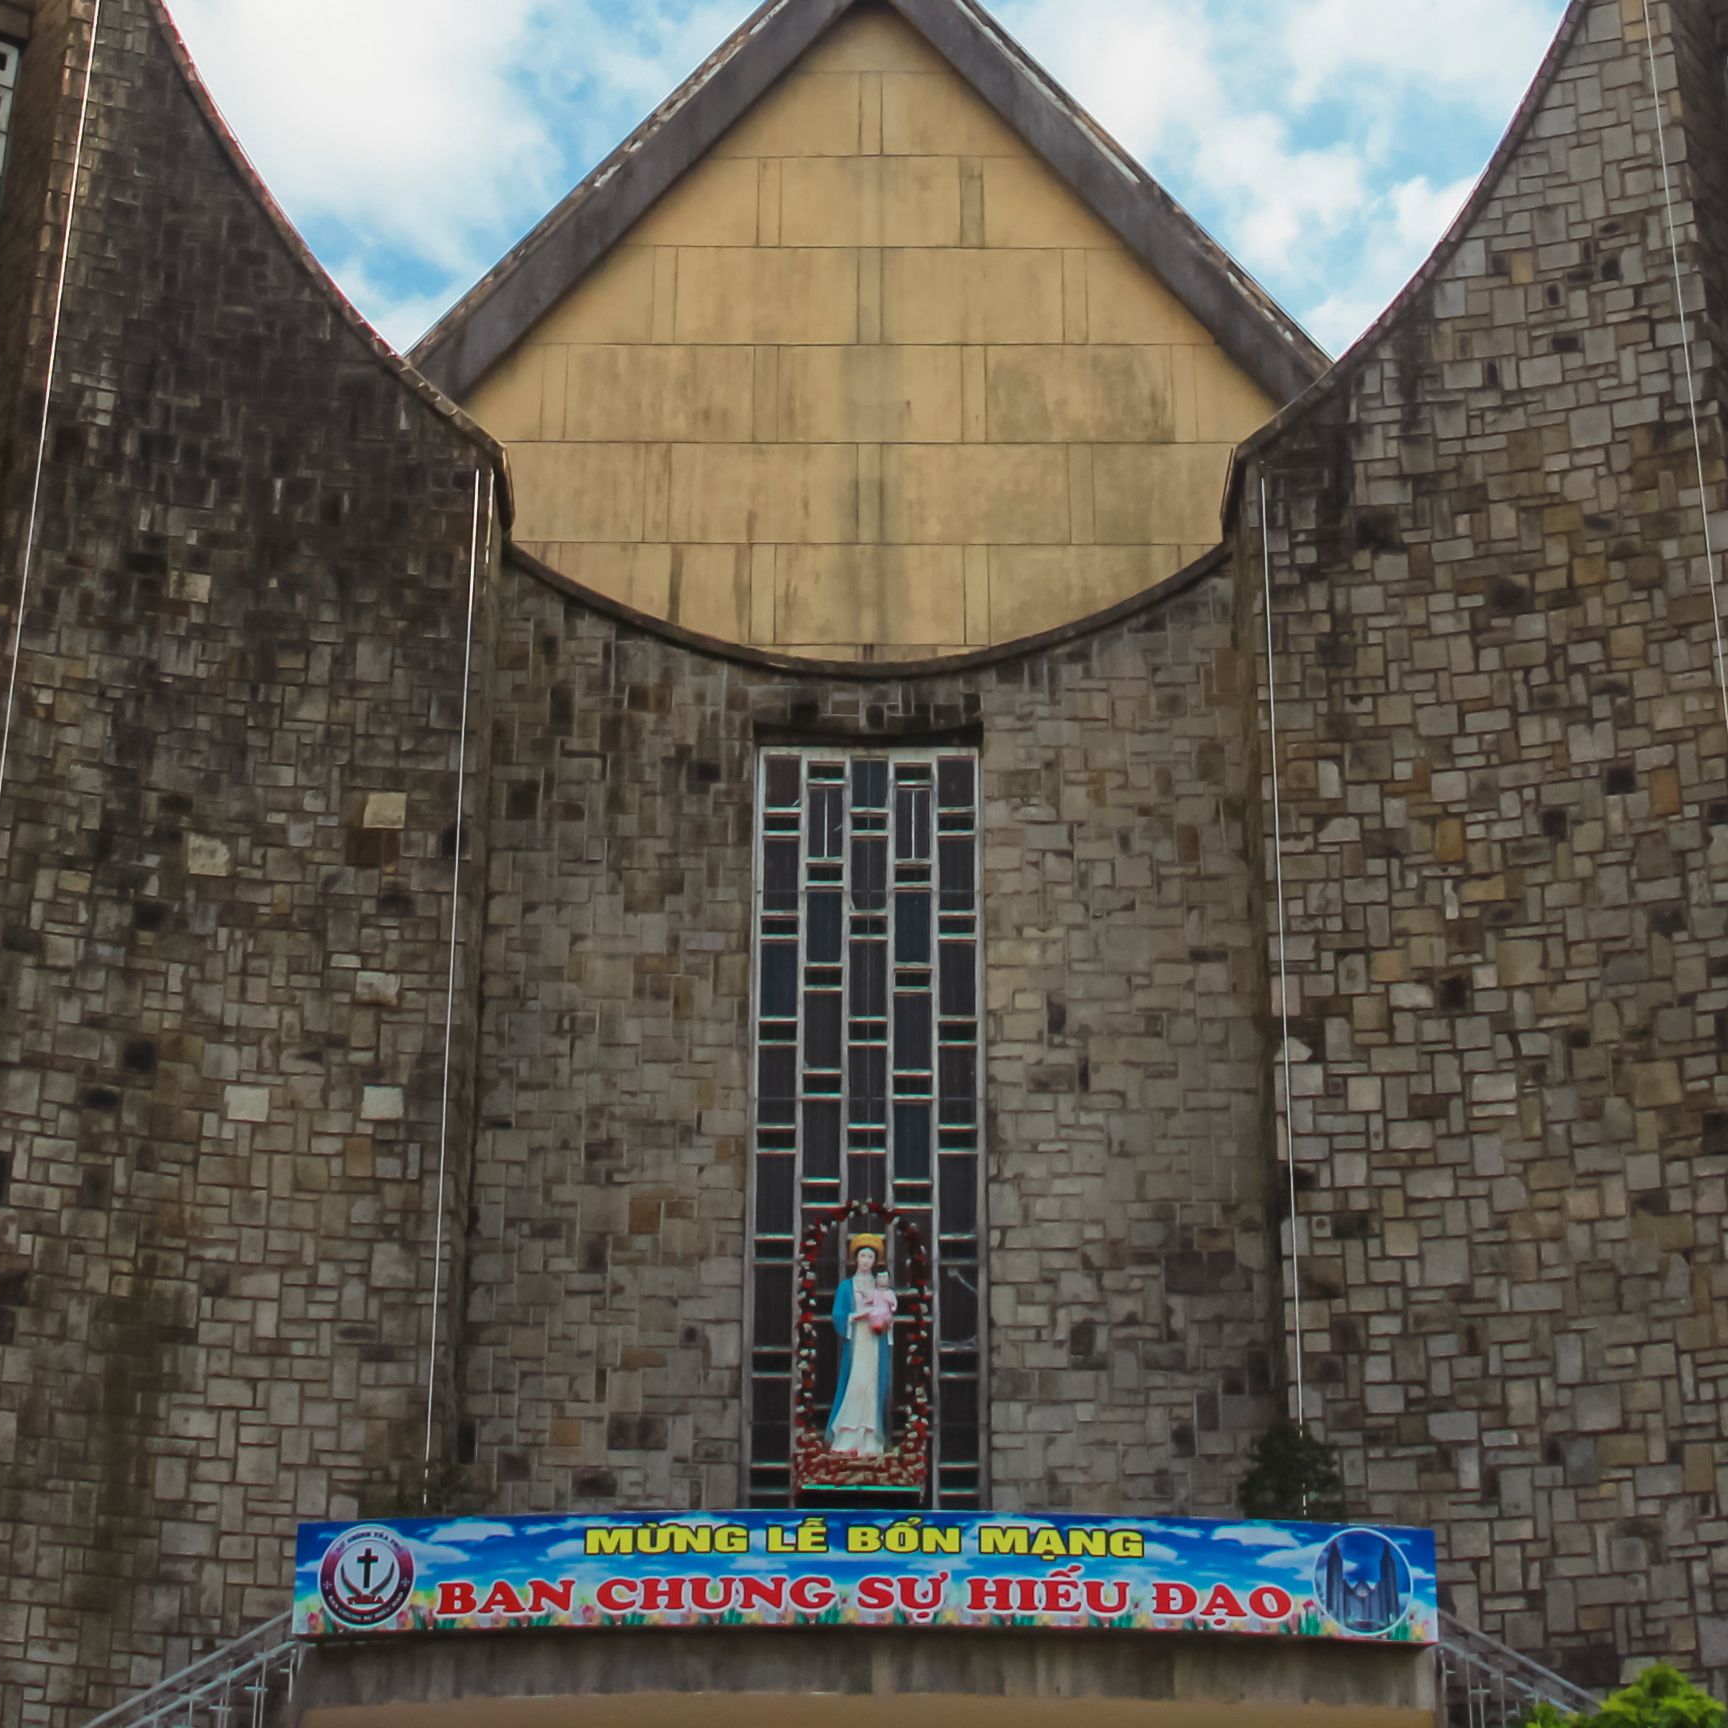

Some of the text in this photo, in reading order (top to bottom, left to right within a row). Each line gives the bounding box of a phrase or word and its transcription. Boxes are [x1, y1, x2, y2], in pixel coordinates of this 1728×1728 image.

[584, 1516, 1145, 1561] MỪNG LỄ BỔN MẠNG
[436, 1579, 576, 1615] BAN
[596, 1576, 836, 1611] CHUNG
[857, 1571, 950, 1619] SỰ
[966, 1564, 1131, 1614] HIẾU
[1151, 1582, 1293, 1626] ĐẠO
